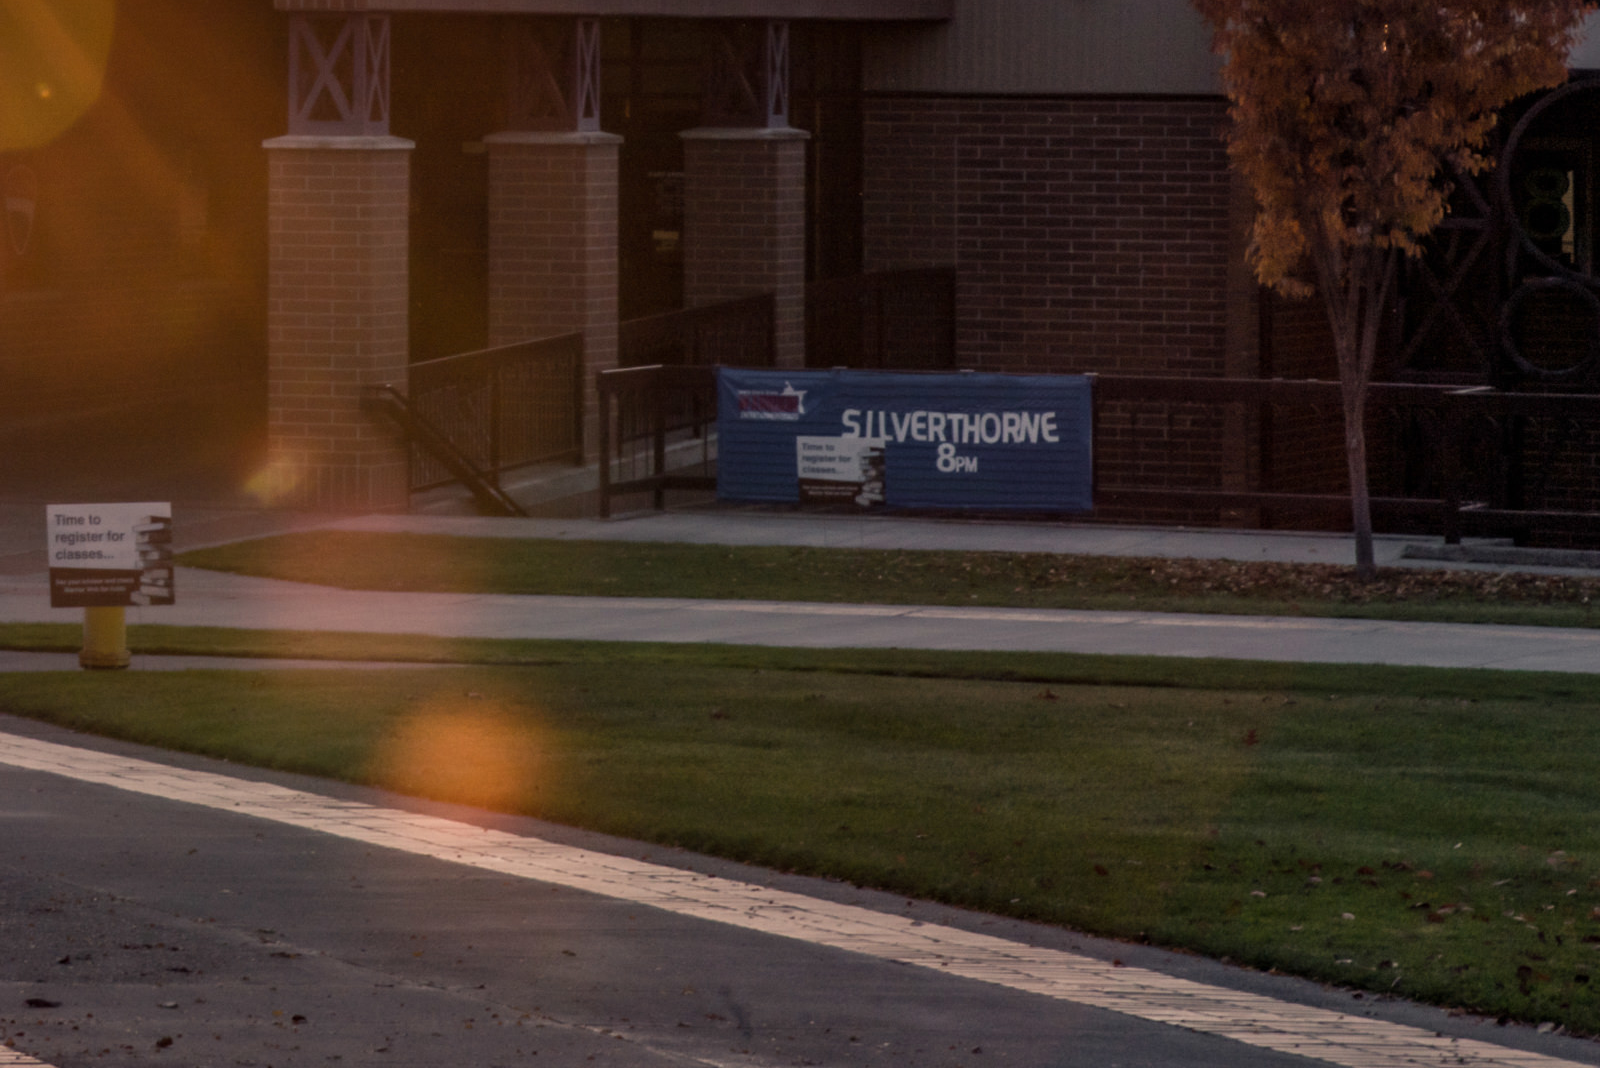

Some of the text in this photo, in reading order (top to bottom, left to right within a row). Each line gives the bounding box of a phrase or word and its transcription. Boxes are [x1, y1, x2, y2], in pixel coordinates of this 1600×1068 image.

[842, 409, 1060, 443] SILVERTHORNE
[936, 443, 978, 473] 8PM
[54, 514, 101, 525] Time to
[55, 530, 125, 545] register for
[55, 548, 114, 560] classes...
